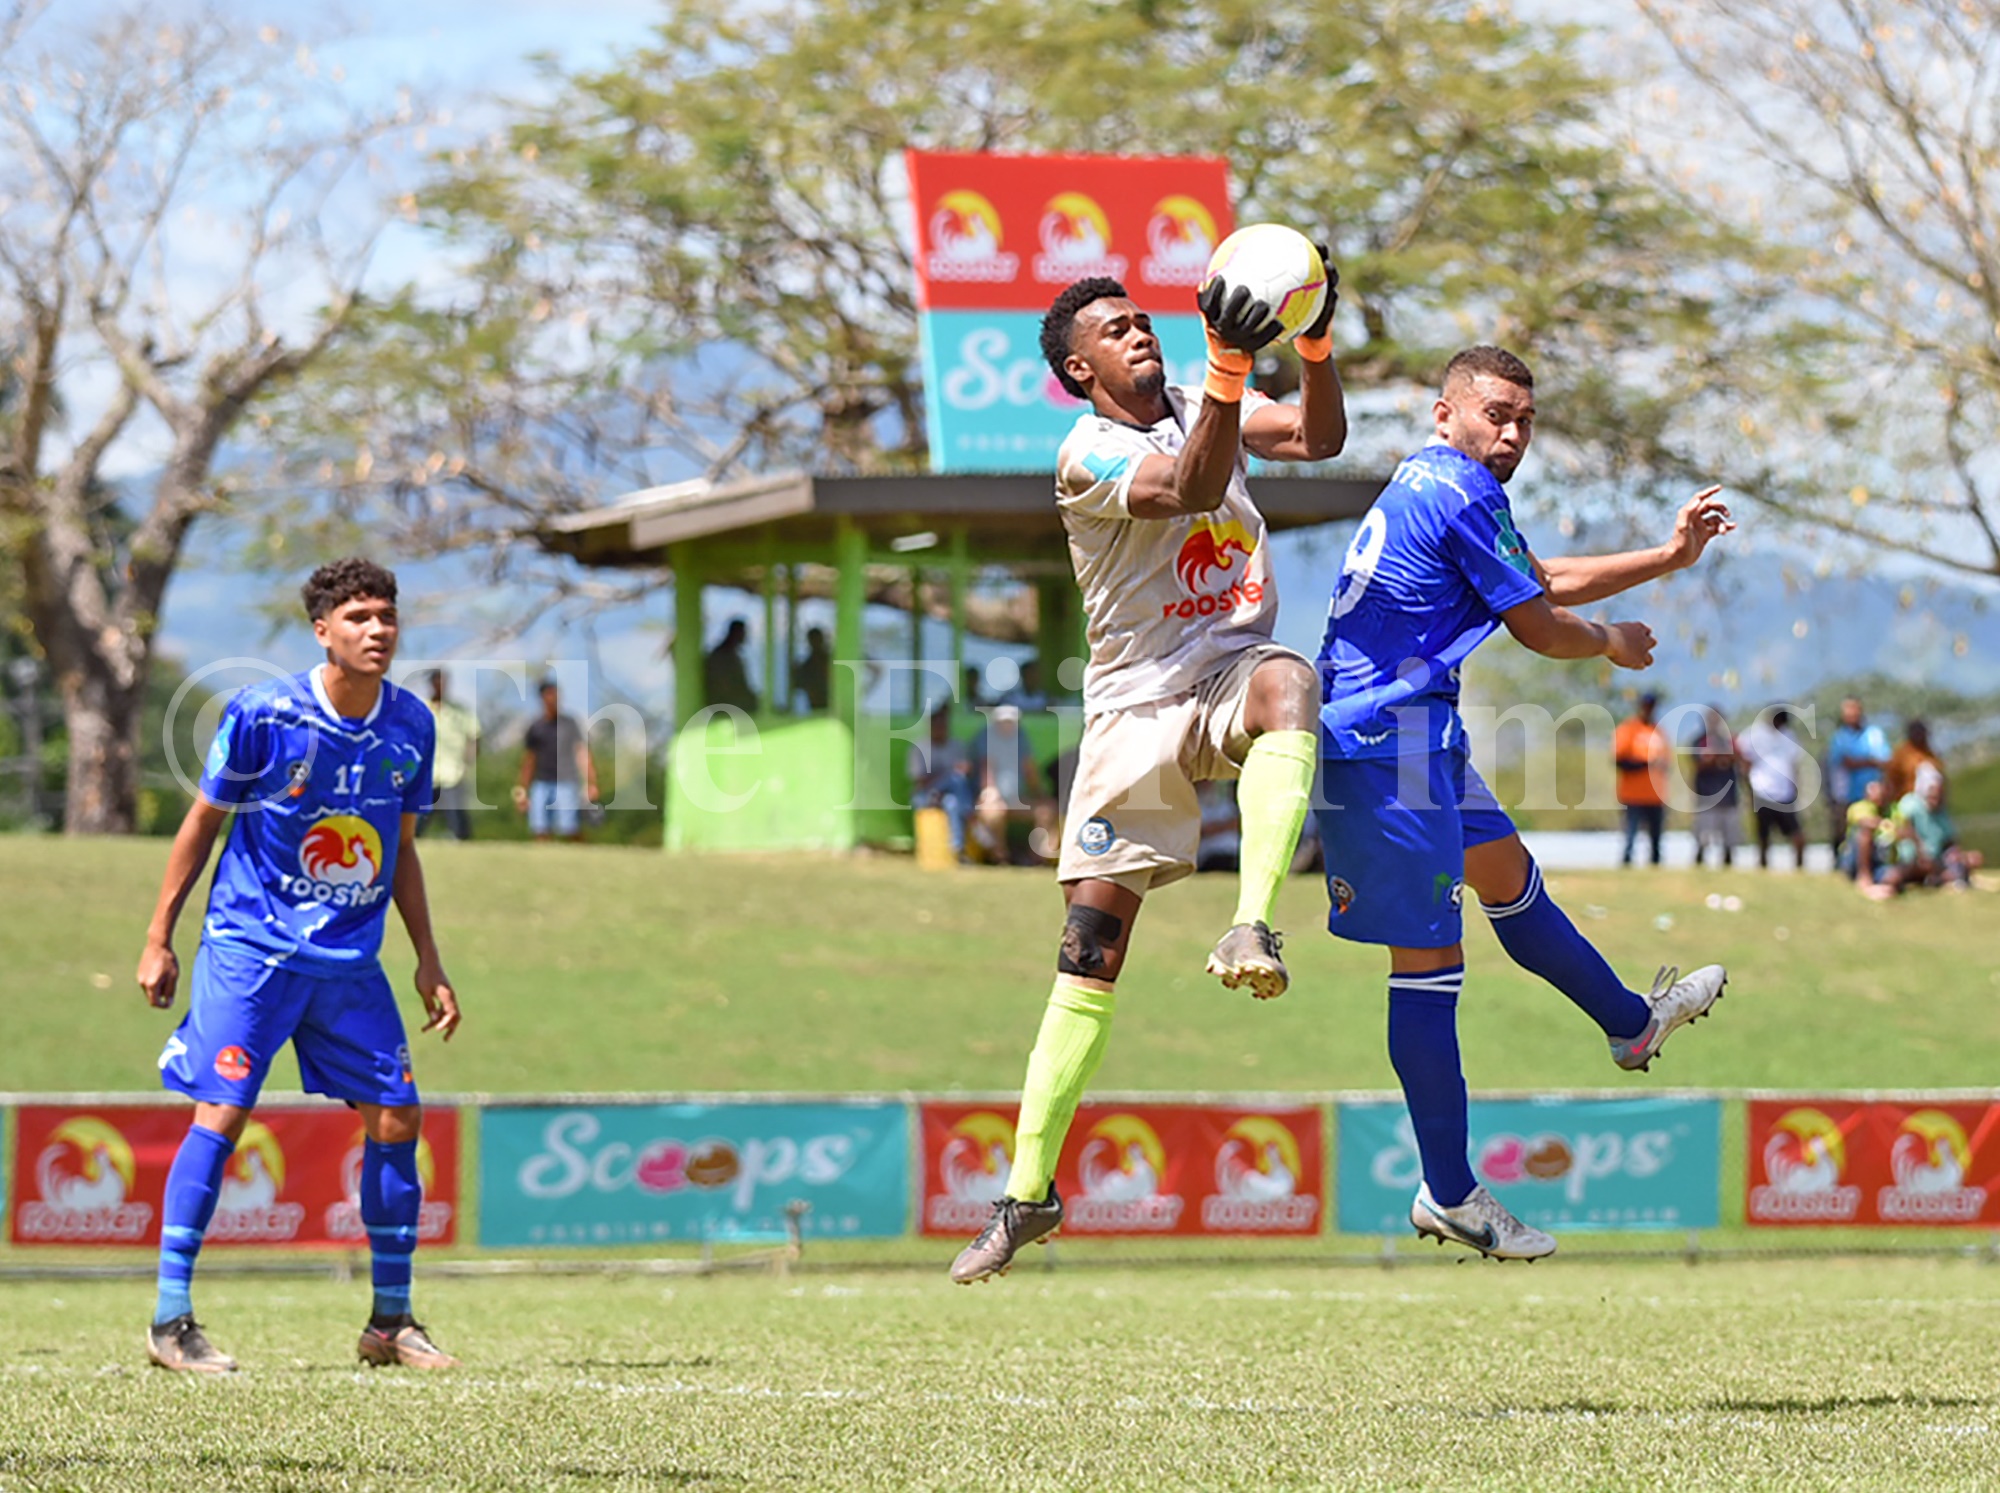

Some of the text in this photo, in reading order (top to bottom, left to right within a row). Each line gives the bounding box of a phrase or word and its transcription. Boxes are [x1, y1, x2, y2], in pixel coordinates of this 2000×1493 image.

[1162, 576, 1270, 619] rooste
[333, 764, 366, 795] 17
[518, 1110, 855, 1212] Scoops
